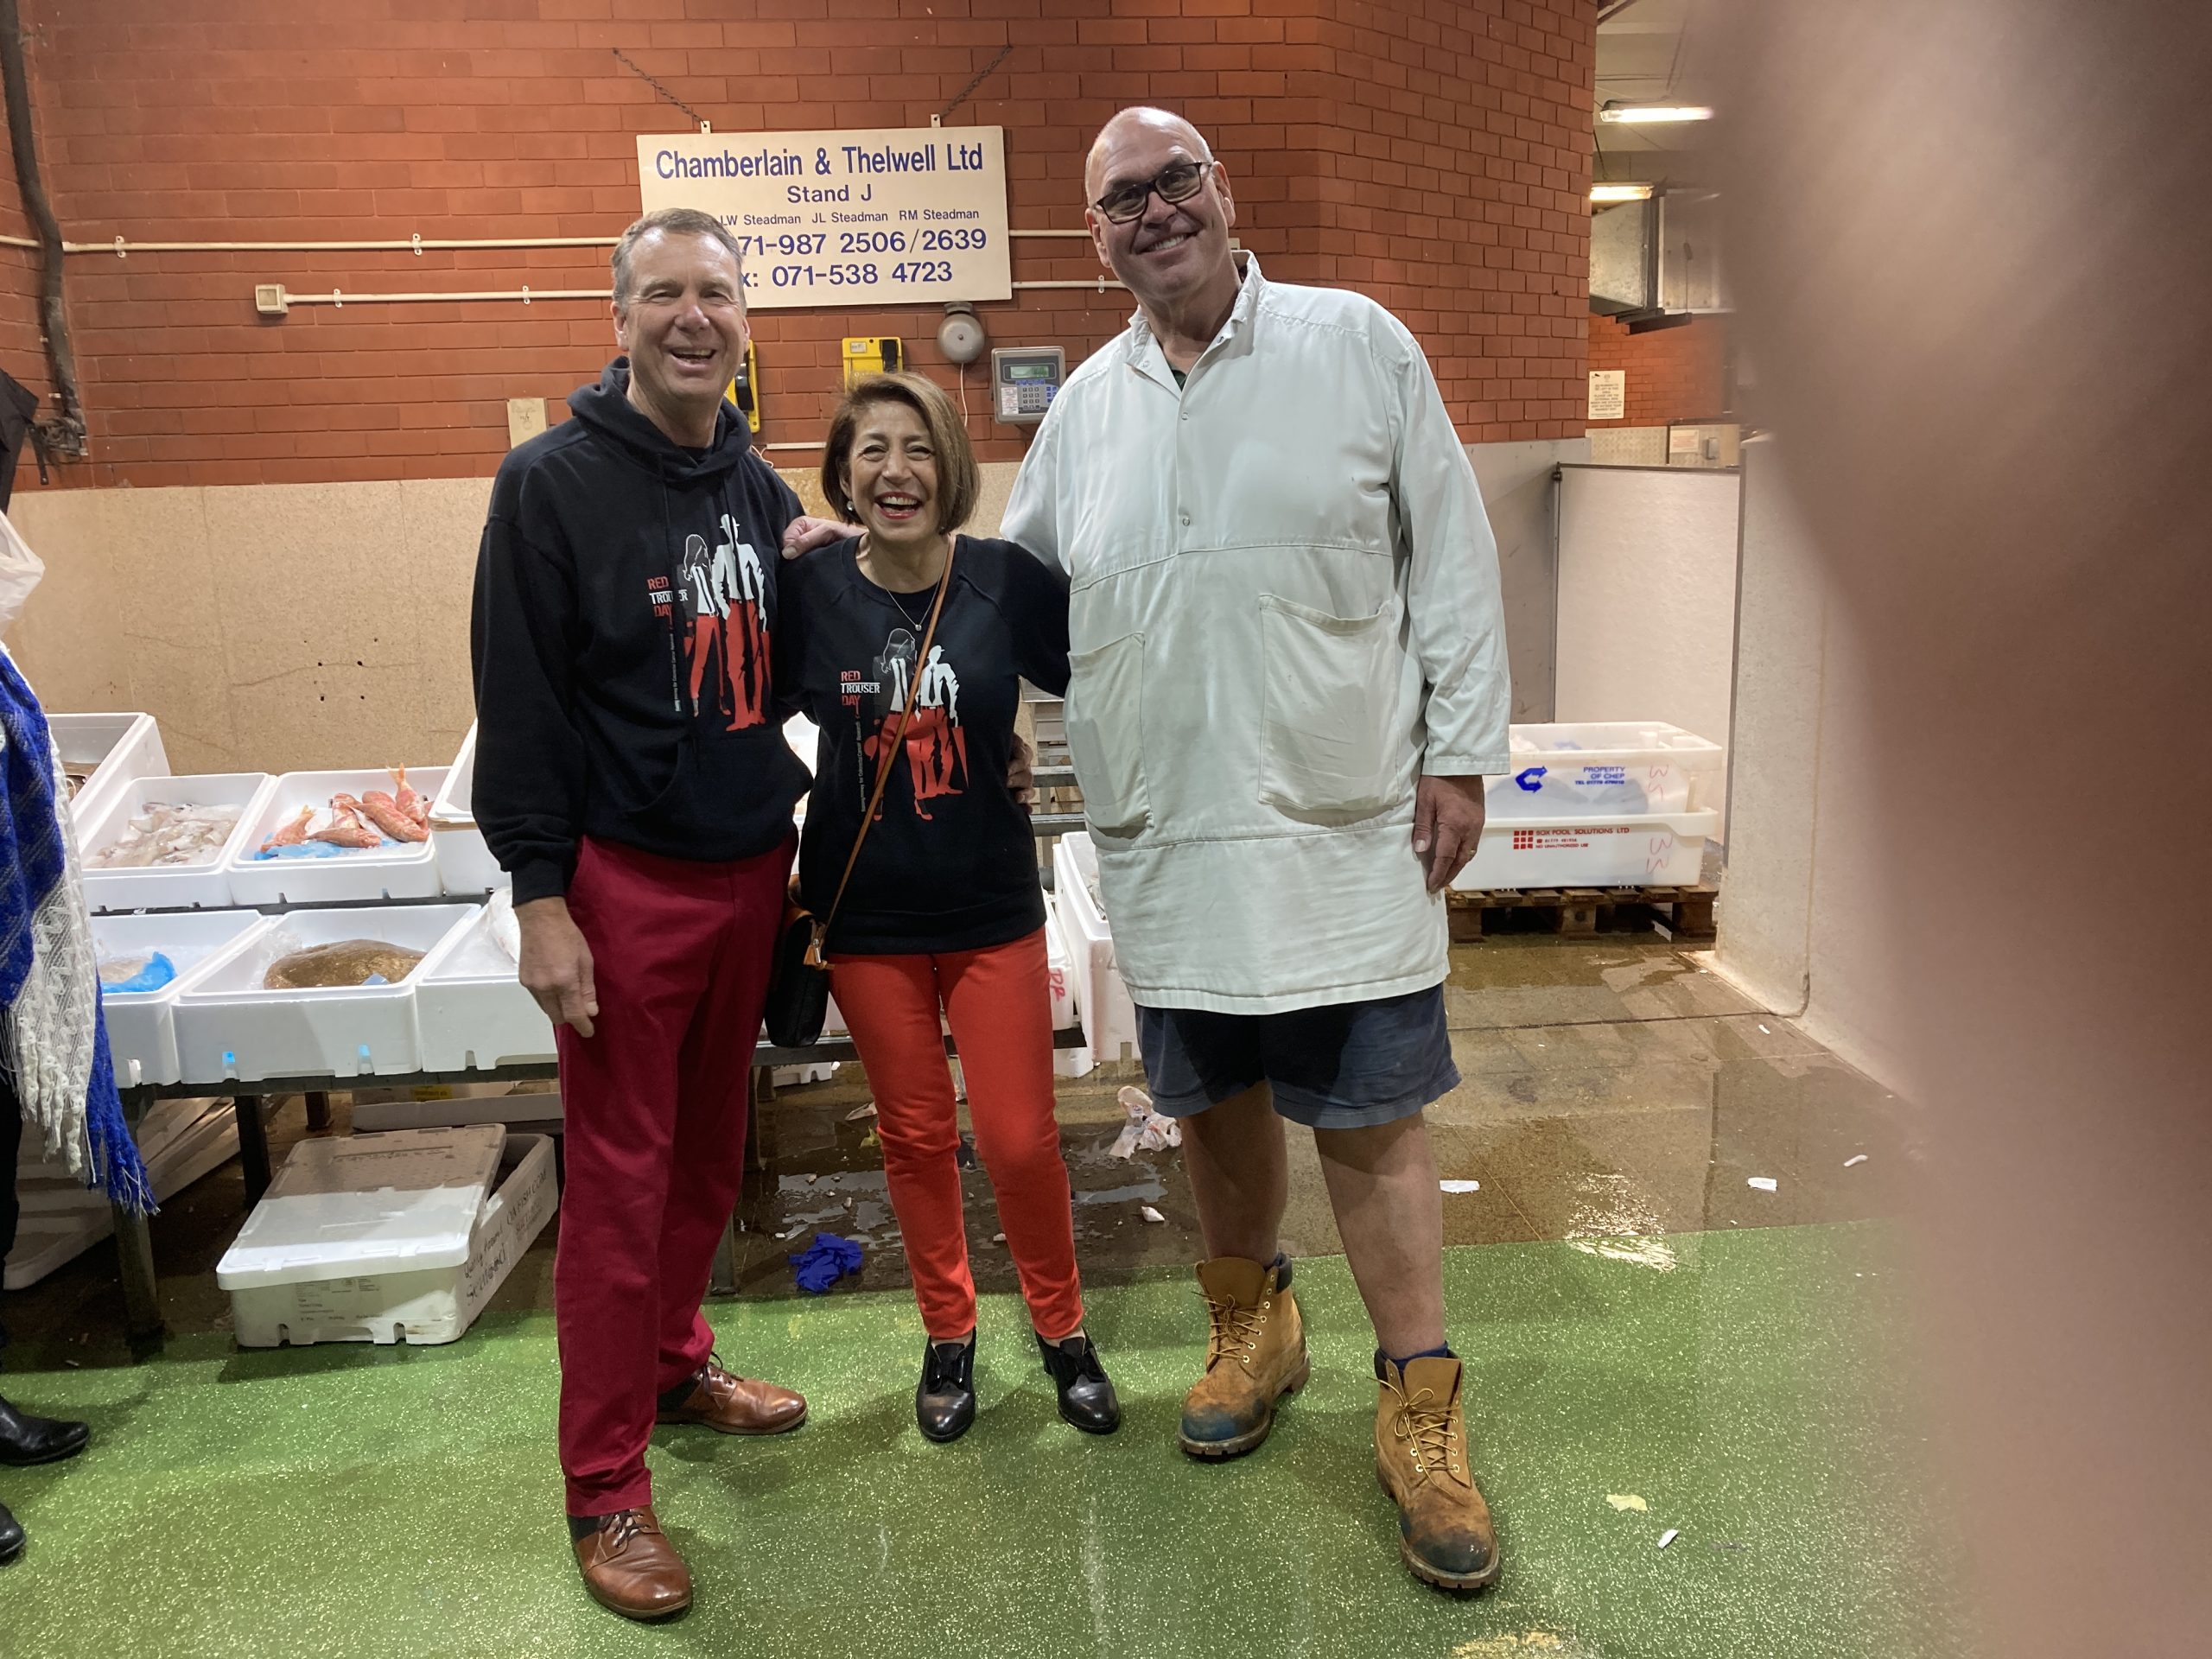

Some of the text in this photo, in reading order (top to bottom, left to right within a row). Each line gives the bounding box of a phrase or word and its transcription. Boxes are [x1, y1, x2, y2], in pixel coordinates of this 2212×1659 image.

[656, 143, 983, 179] Chamberlain & Thelwell Ltd
[787, 183, 872, 204] Stand J
[744, 213, 801, 226] Steadman
[811, 213, 826, 224] JL
[831, 210, 888, 223] Steadman
[899, 209, 918, 220] RM
[924, 208, 980, 219] Steadman
[737, 233, 827, 256] 71-987
[772, 263, 879, 287] 071-538
[892, 261, 953, 283] 4723
[647, 575, 670, 590] RED
[653, 603, 673, 622] DAY
[841, 671, 861, 682] RED
[840, 682, 880, 694] TROUSER
